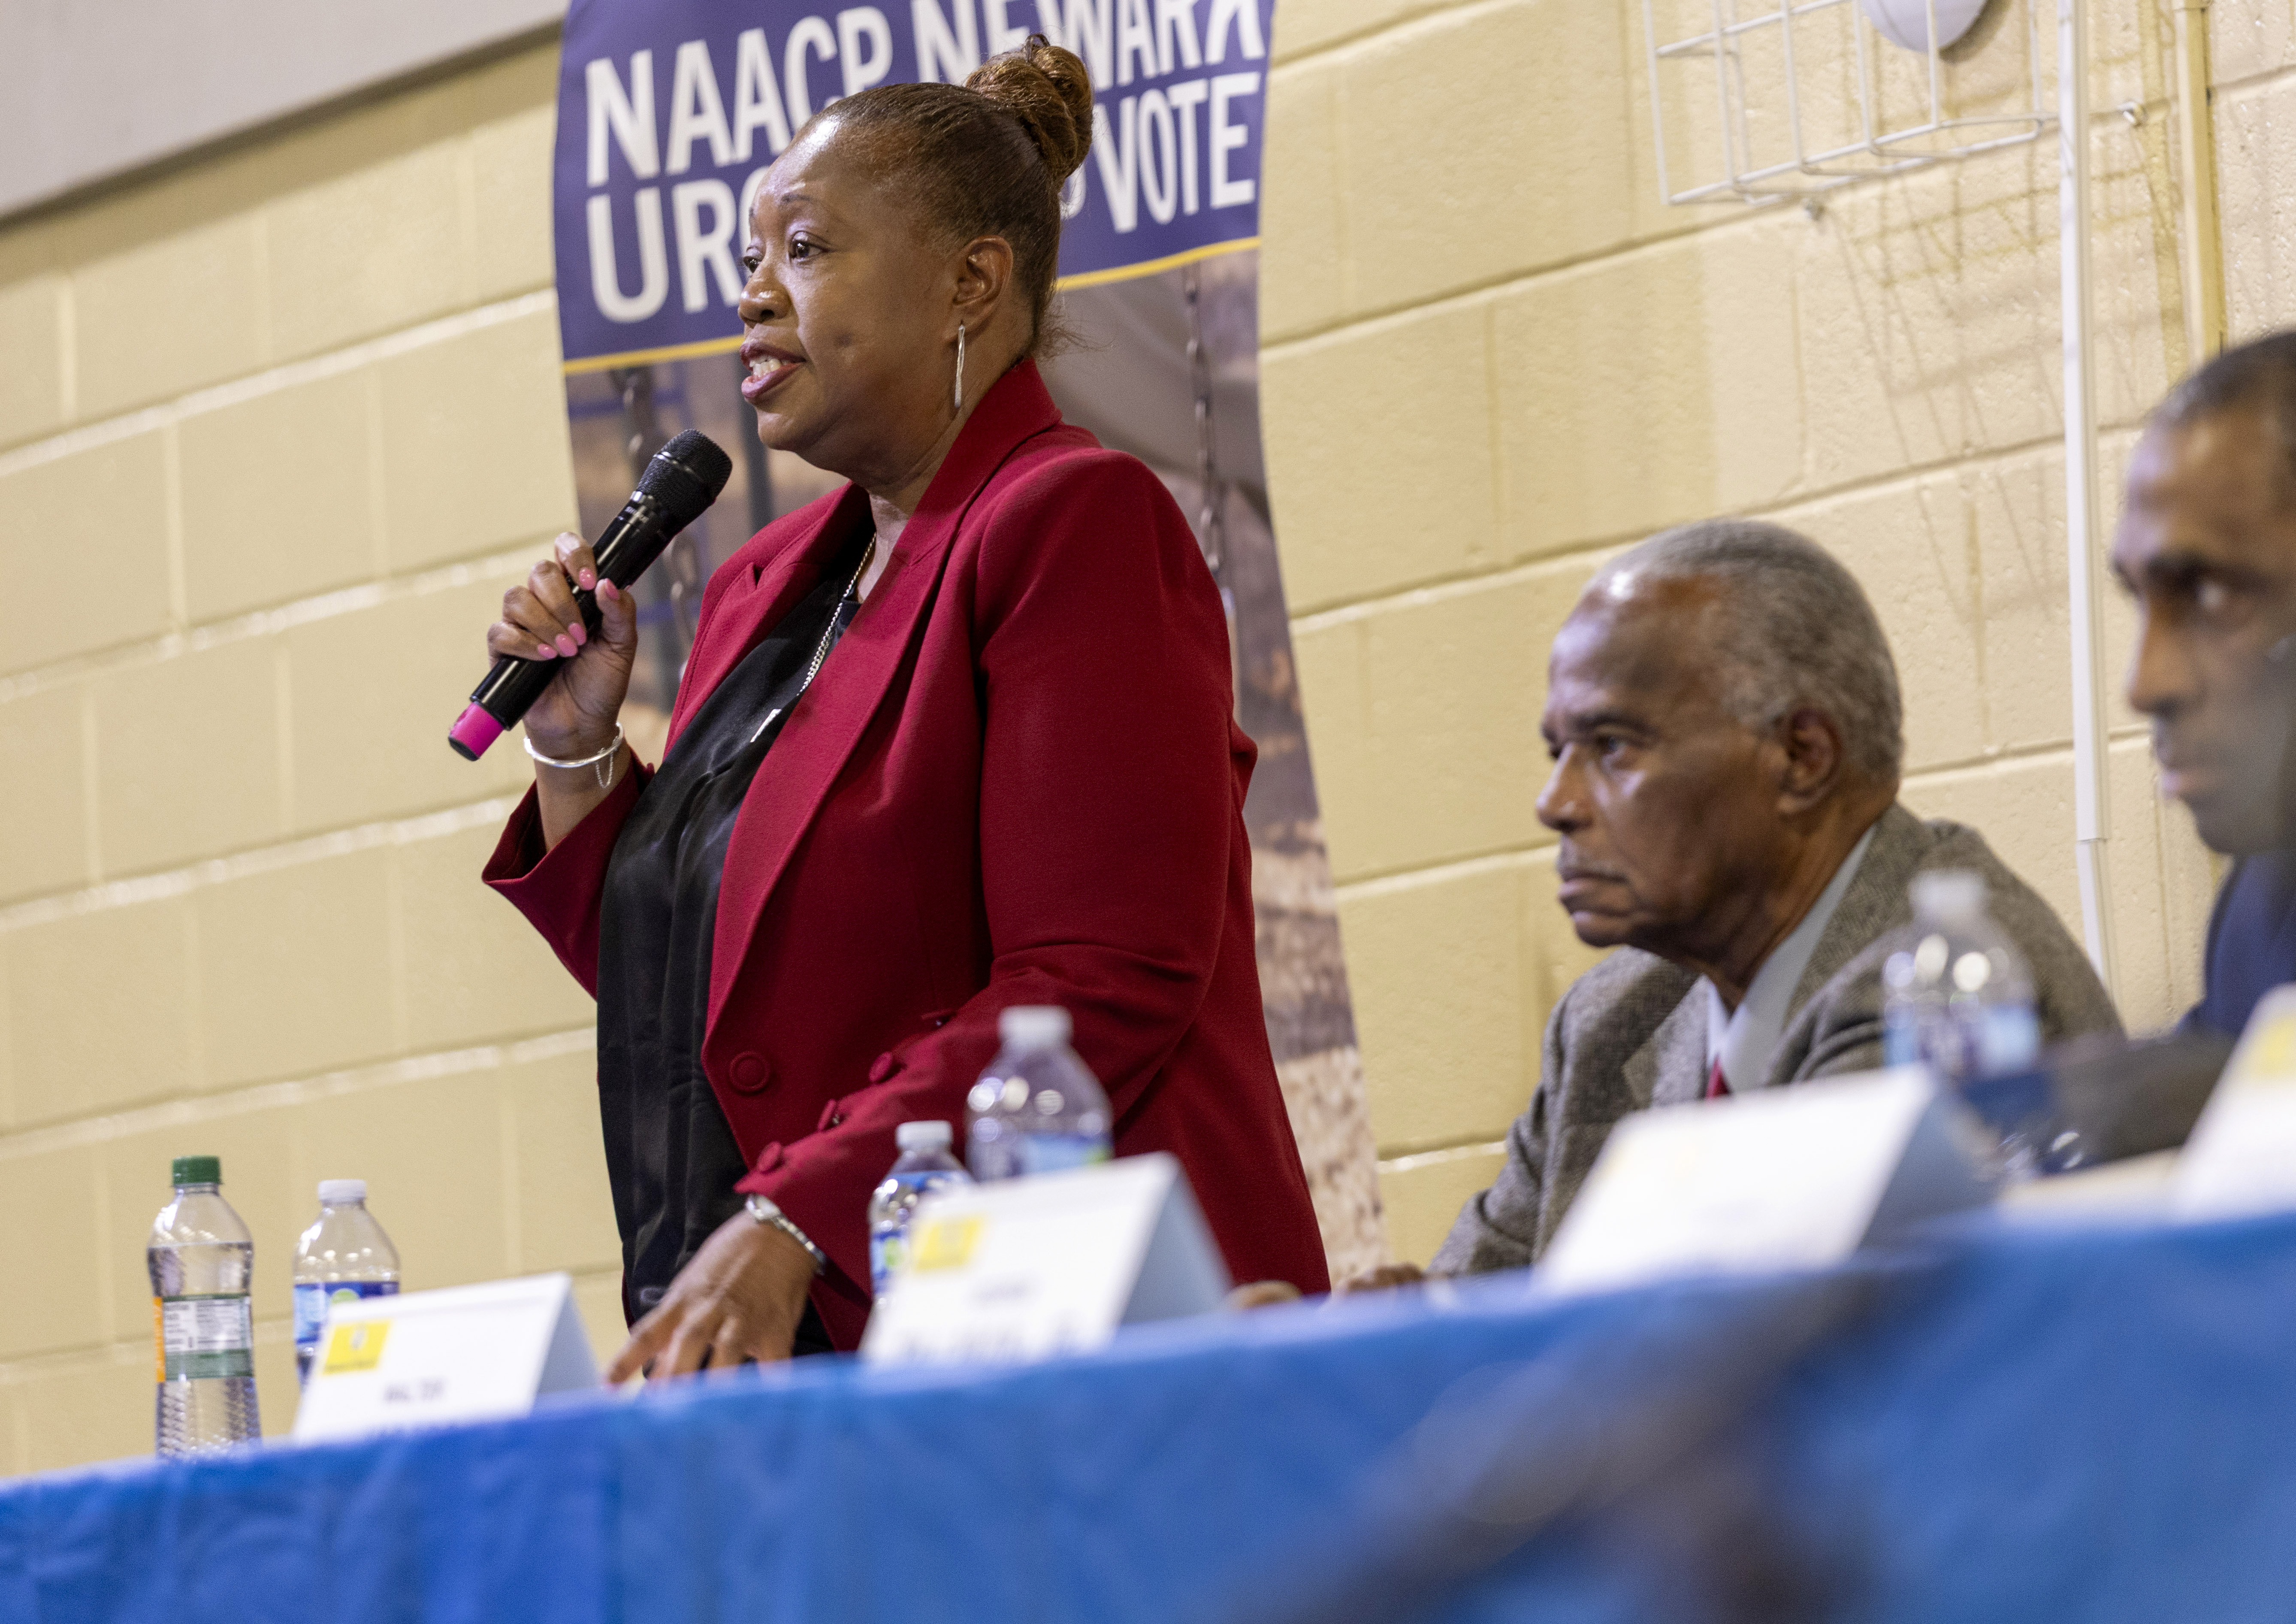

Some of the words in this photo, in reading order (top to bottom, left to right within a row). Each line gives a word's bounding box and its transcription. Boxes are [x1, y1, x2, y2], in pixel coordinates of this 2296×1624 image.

[586, 6, 893, 187] NAACP
[586, 166, 769, 323] UR
[1092, 72, 1260, 233] VOTE
